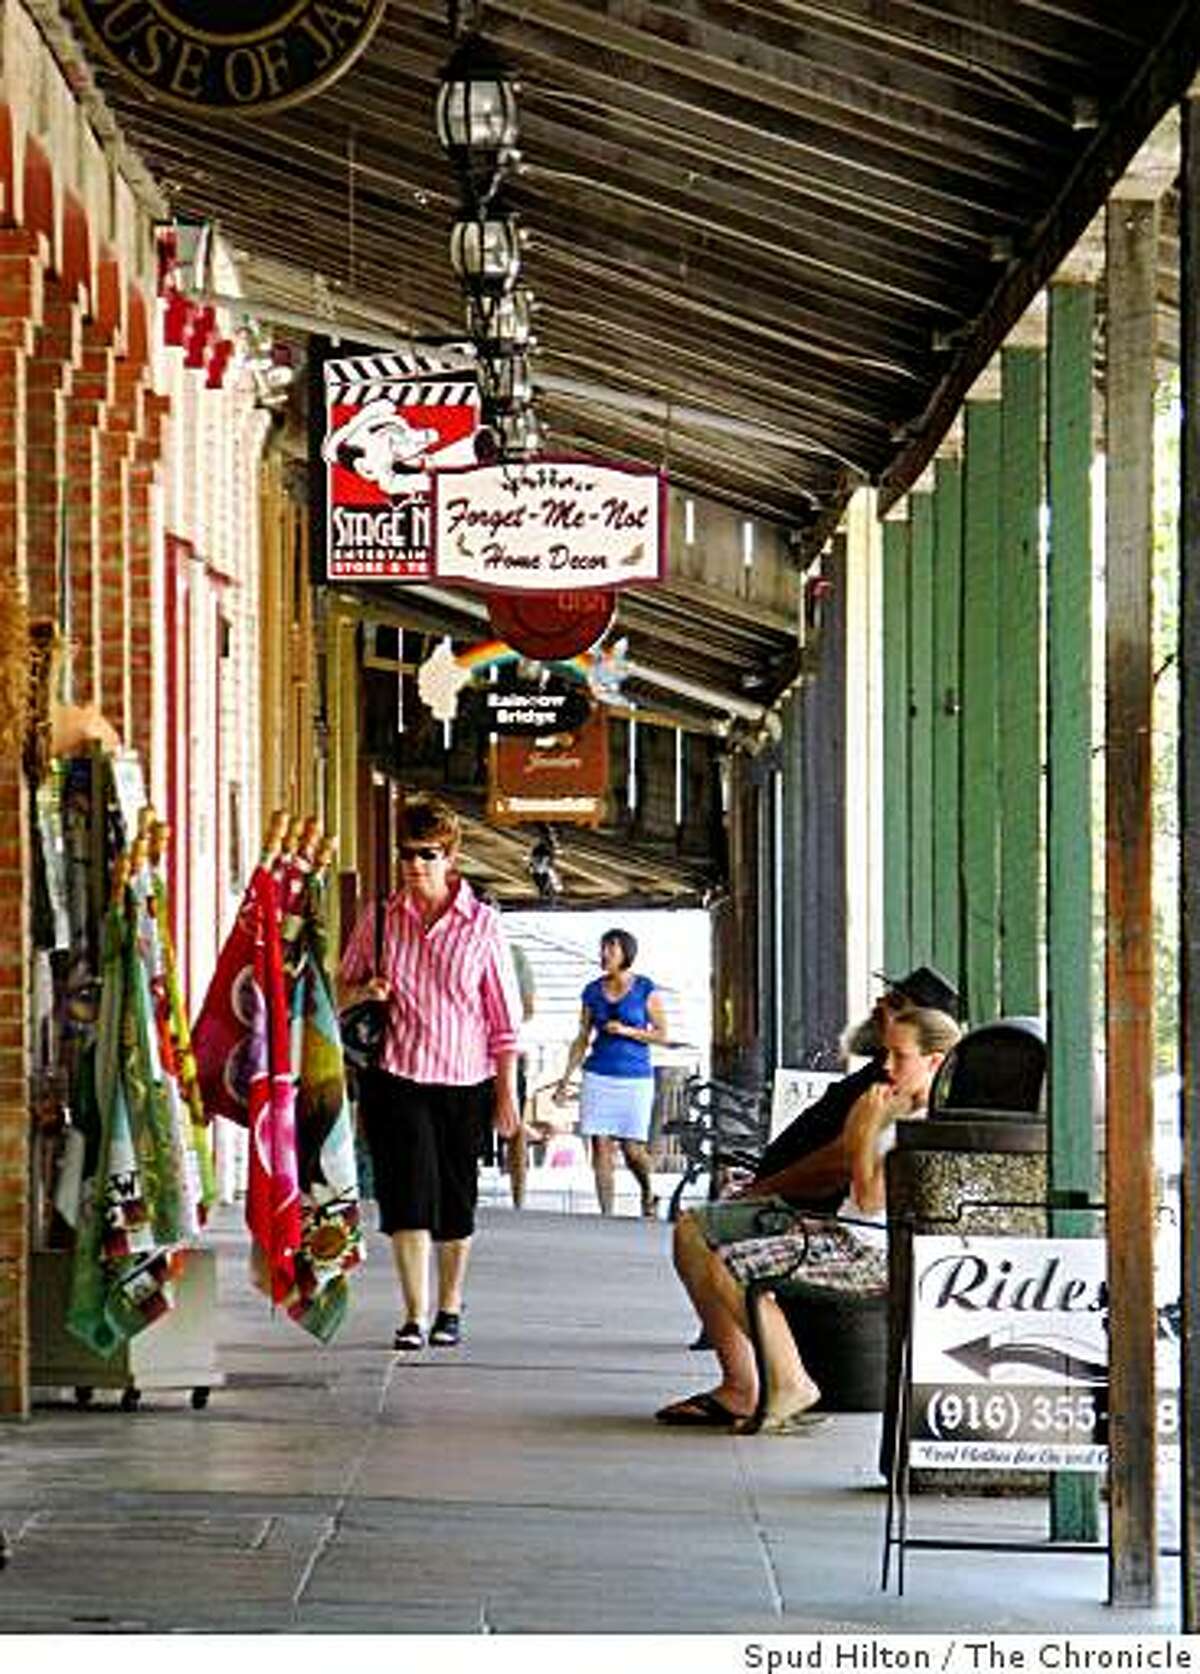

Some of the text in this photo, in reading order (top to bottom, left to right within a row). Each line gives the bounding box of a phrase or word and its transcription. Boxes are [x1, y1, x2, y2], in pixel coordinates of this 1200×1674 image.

[224, 39, 289, 100] OF
[333, 506, 407, 547] STAGE
[446, 497, 649, 537] Forget-Me-Not
[481, 542, 608, 570] Home Decor
[497, 709, 557, 726] Bridge
[918, 1253, 1110, 1312] Rides
[926, 1390, 1021, 1438] (916)
